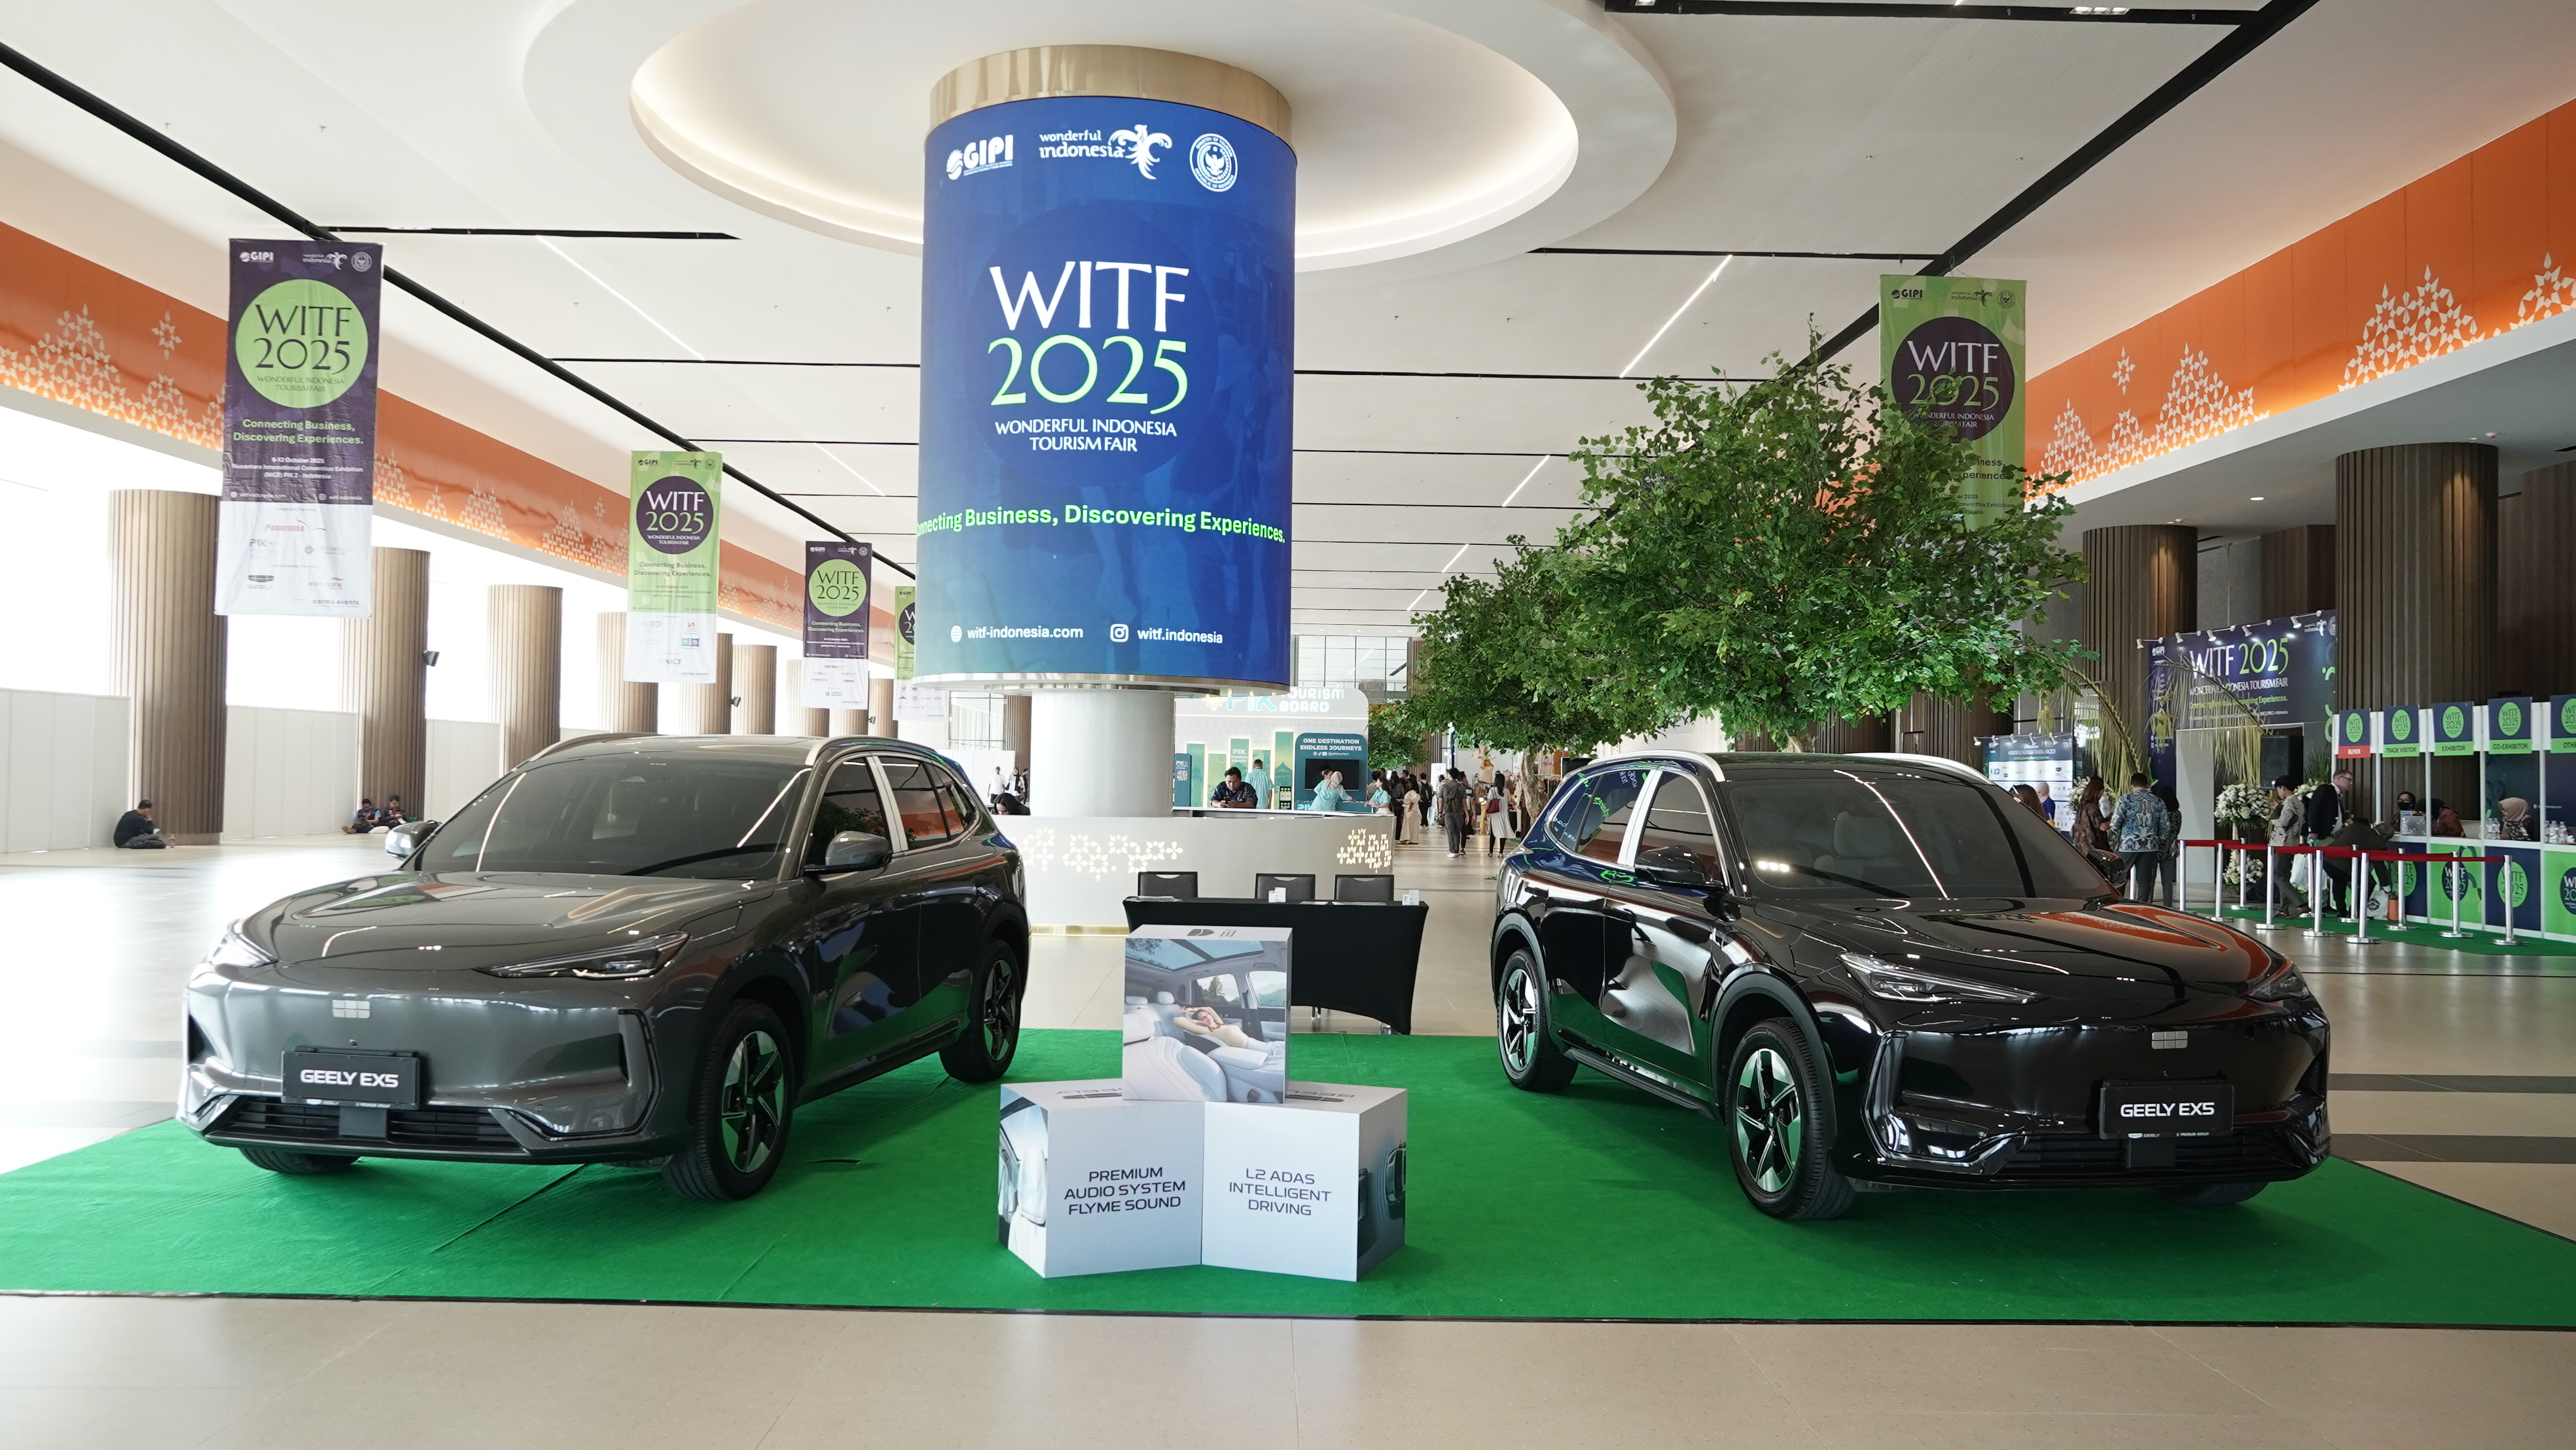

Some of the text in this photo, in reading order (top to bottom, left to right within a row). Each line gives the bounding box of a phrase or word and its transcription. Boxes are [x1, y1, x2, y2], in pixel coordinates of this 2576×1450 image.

[1039, 130, 1101, 143] wonderful
[963, 134, 1014, 169] GIPI
[1039, 142, 1124, 158] indonesia
[250, 251, 274, 261] GIPI
[990, 261, 1189, 332] WITF
[1901, 289, 1923, 298] GIPI
[255, 304, 351, 336] WITF
[254, 338, 350, 375] 2025
[1907, 340, 2000, 374] WITF
[988, 334, 1188, 414] 2025
[1906, 374, 1999, 412] 2025
[243, 419, 355, 432] Connecting Business,
[995, 418, 1177, 437] WONDERFUL INDONESIA
[234, 432, 364, 444] Discovering Experiences.
[1029, 436, 1137, 452] TOURISM FAIR
[1963, 471, 2005, 480] perience
[646, 491, 705, 510] WITF
[645, 512, 704, 534] 2025
[916, 504, 1285, 543] onnecting Business, Discovering Experiences.
[817, 571, 859, 584] WITF
[816, 585, 859, 601] 2025
[967, 625, 1084, 641] witf-indonesia.com
[1137, 628, 1223, 644] witf.indonesia
[2189, 637, 2289, 679] WITF 2025
[1281, 688, 1344, 699] OURISM
[1227, 696, 1277, 712] PIK
[1279, 701, 1330, 713] BOARD
[2445, 712, 2461, 720] WITF
[2501, 708, 2518, 718] WITF
[2446, 720, 2461, 729] 2025
[2501, 717, 2518, 726] 2025
[300, 1069, 399, 1088] GEELY EX5
[2120, 1102, 2215, 1118] GEELY EX5
[1088, 1167, 1164, 1182] PREMIUM
[1246, 1168, 1315, 1185] L2 ADAS
[1064, 1180, 1186, 1200] AUDIO SYSTEM
[1229, 1182, 1332, 1202] INTELLIGENT
[1068, 1196, 1181, 1215] FLYME SOUND
[1248, 1199, 1312, 1216] DRIVING
